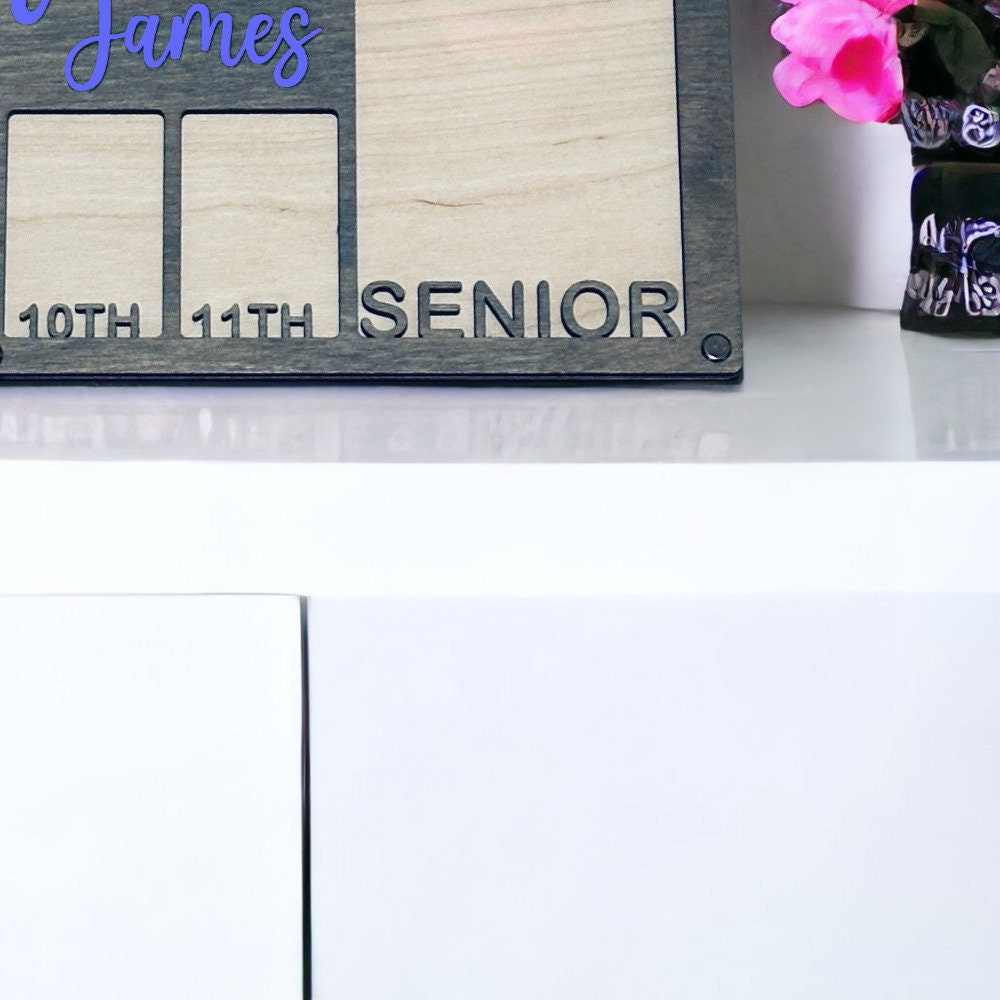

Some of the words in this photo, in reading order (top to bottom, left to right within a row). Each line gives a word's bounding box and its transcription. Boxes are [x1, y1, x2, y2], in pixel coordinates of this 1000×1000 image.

[18, 302, 140, 339] 10TH
[191, 302, 313, 339] 11TH
[360, 279, 681, 339] SENIOR
